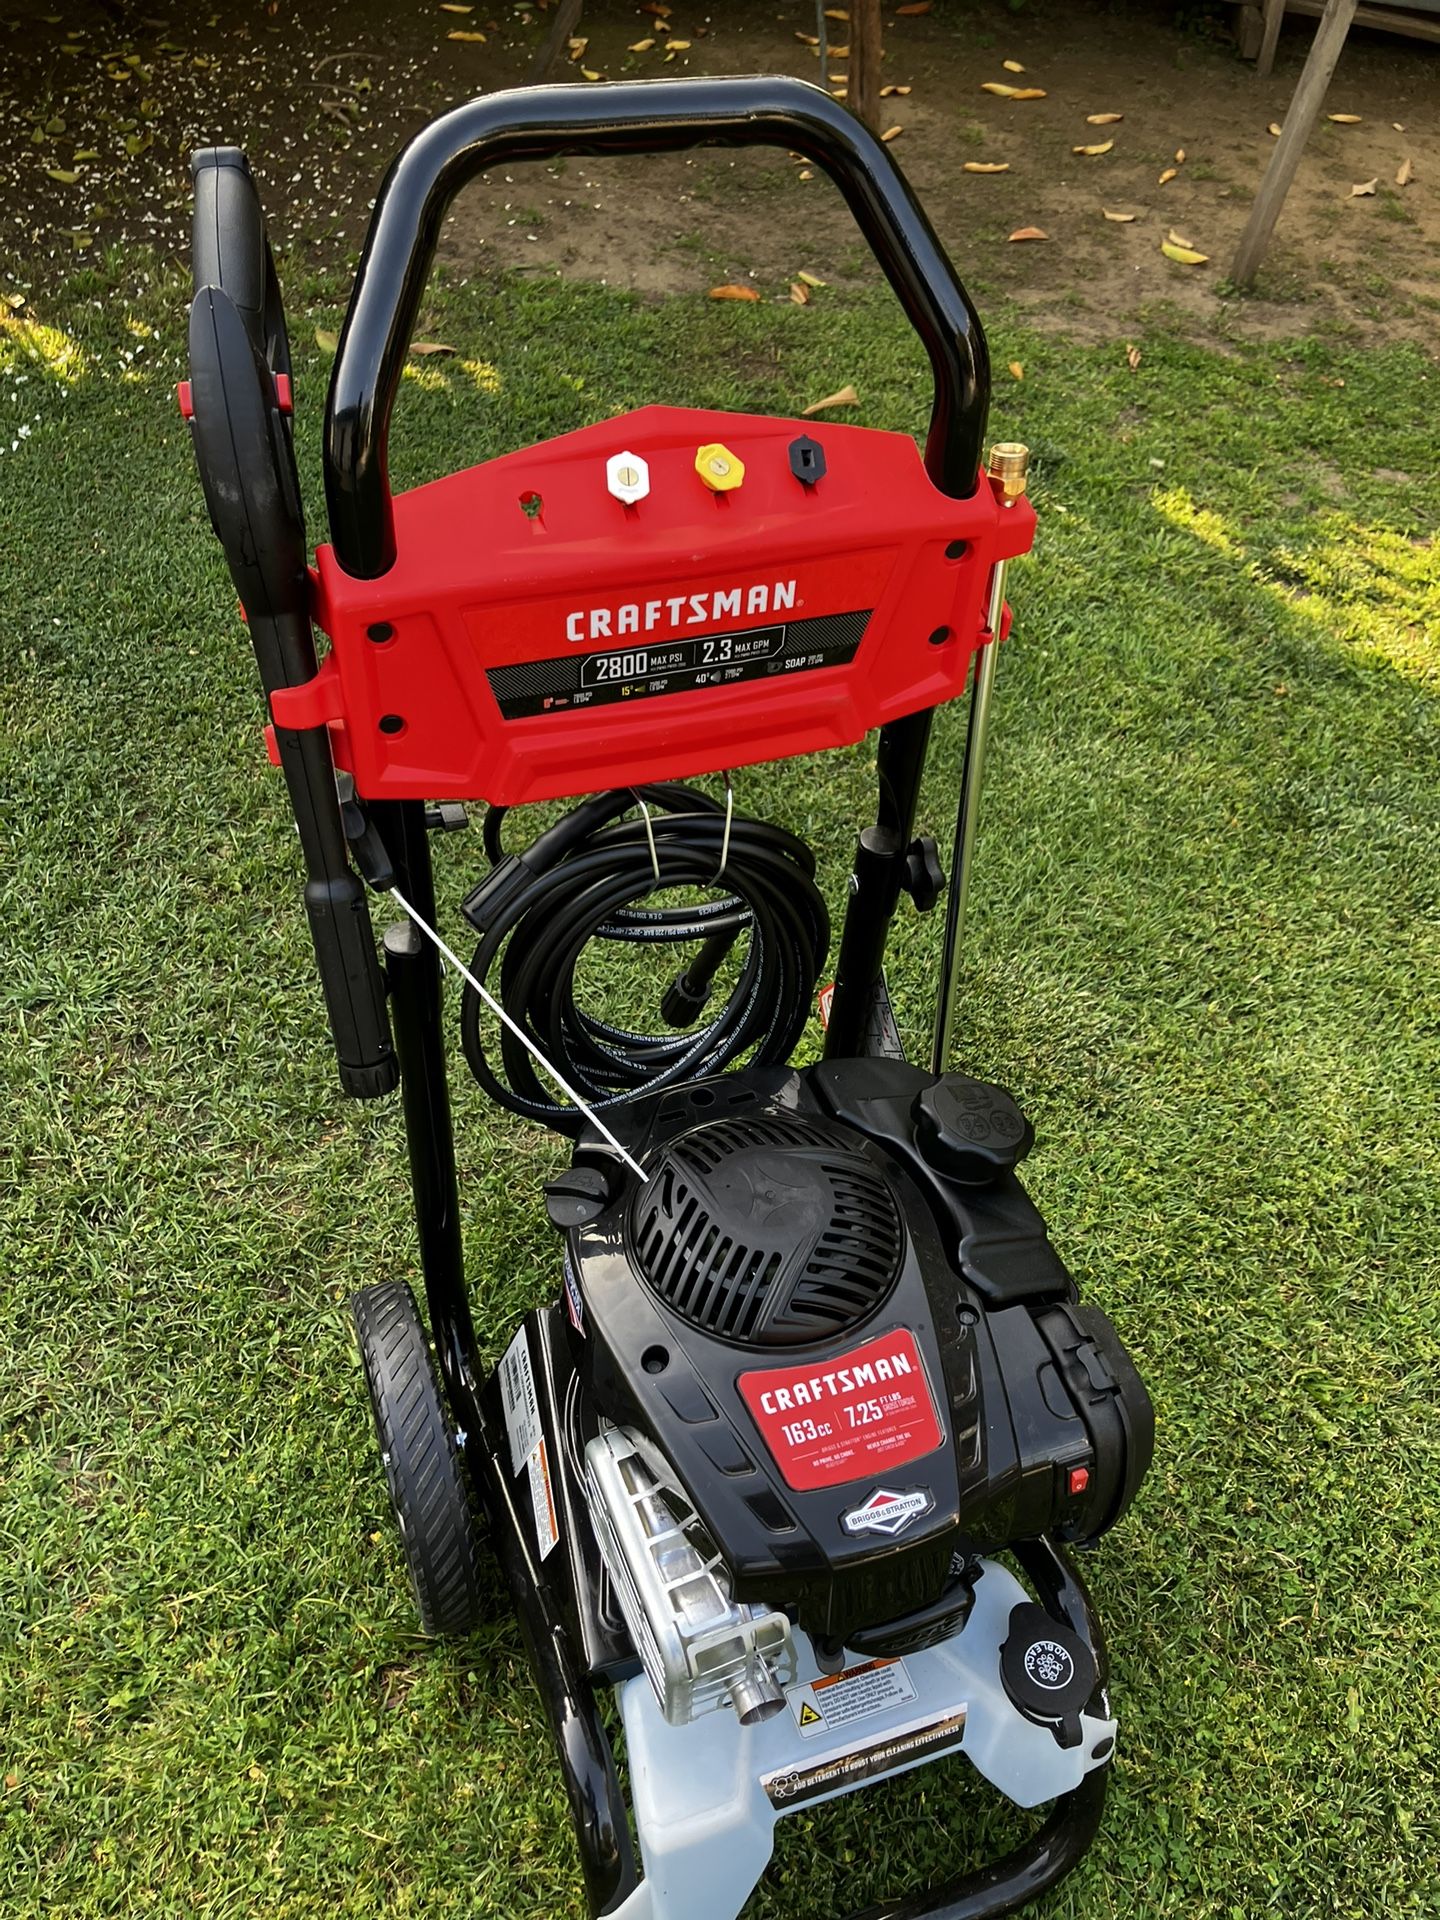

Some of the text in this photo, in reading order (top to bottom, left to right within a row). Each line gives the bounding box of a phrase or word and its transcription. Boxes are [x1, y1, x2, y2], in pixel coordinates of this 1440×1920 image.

[566, 580, 797, 642] CRAFTSMAN
[702, 639, 732, 663] 2.3
[735, 644, 751, 653] MAX
[753, 639, 770, 650] GPM
[785, 656, 806, 669] SOAP
[596, 652, 647, 680] 2800
[650, 655, 667, 666] MAX
[669, 653, 683, 663] PSI
[520, 1349, 536, 1415] CRAFTSMAN
[760, 1352, 912, 1415] CRAFTSMAN
[879, 1392, 902, 1404] FT LBS
[843, 1399, 884, 1428] 7.25
[1027, 1642, 1068, 1670] NO BLEACH
[816, 1685, 836, 1697] Chemical
[834, 1682, 845, 1690] Burn
[859, 1669, 880, 1681] Chemicals
[879, 1665, 891, 1674] could
[840, 1693, 850, 1702] NOT
[882, 1678, 892, 1686] with
[842, 1683, 861, 1694] resulting
[863, 1678, 876, 1687] death
[823, 1703, 842, 1714] pressure
[856, 1694, 866, 1702] Use
[864, 1690, 877, 1699] ONLY
[876, 1684, 894, 1695] pressure
[825, 1709, 842, 1720] washer
[840, 1706, 851, 1714] safe
[793, 1724, 960, 1791] ADD DETERGENT TO BOOST YOUR CLEANING EFFECTIVENESS
